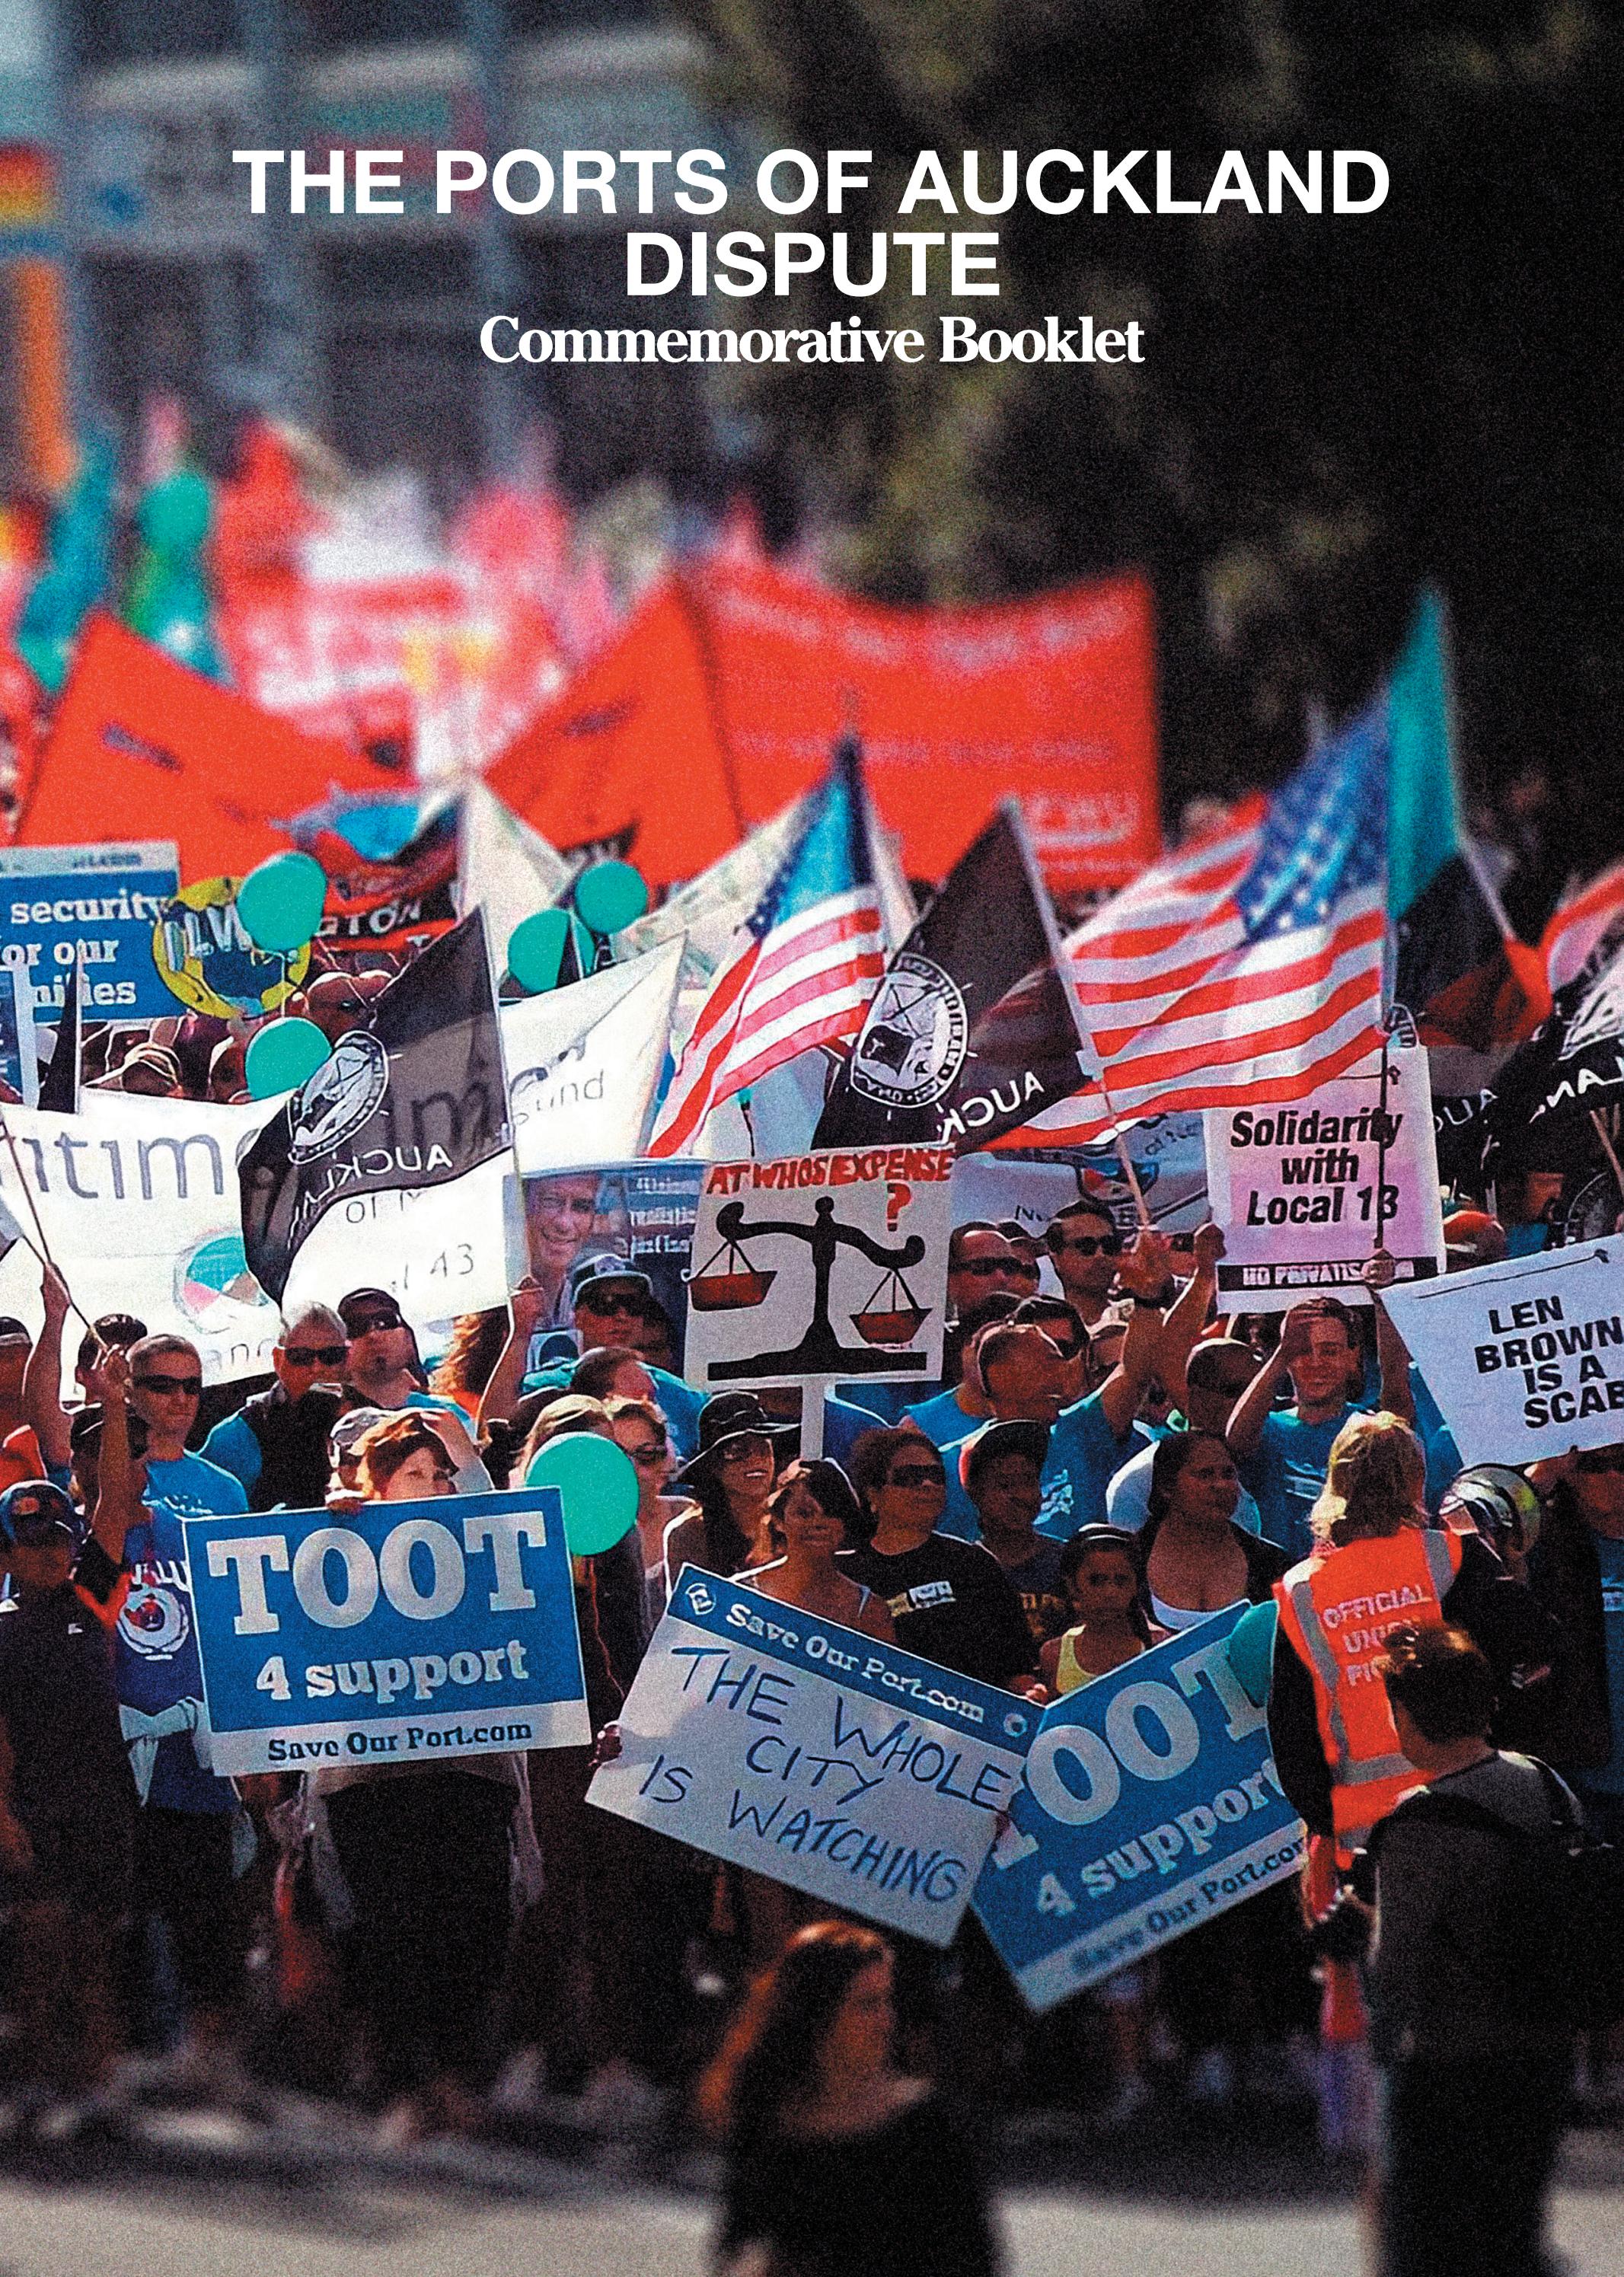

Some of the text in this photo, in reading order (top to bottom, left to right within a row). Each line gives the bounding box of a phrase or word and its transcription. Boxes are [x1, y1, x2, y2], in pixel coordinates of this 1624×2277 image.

[11, 888, 169, 926] security
[0, 935, 119, 966] or our
[1230, 1108, 1403, 1149] Solidarity
[706, 1163, 751, 1194] AT
[1281, 1147, 1359, 1185] with
[885, 1182, 911, 1233] ?
[1246, 1185, 1399, 1226] Local 13
[1243, 1267, 1270, 1285] NO
[1488, 1296, 1565, 1335] LEN
[1474, 1315, 1624, 1374] BROWN
[1523, 1354, 1608, 1395] IS A
[206, 1510, 547, 1636] TOOT
[1322, 1583, 1434, 1629] OFFICIAL
[256, 1639, 530, 1704] 4 support
[725, 1603, 985, 1724] Save Our Port.com
[268, 1723, 532, 1762] Save Our Port.com
[671, 1647, 1012, 1812] THE WHOLE
[746, 1735, 885, 1806] CITY
[991, 1636, 1268, 1870] OOT
[638, 1754, 967, 1903] IS WATCHING
[1037, 1873, 1077, 1917] 4
[1147, 1898, 1198, 1934] Our
